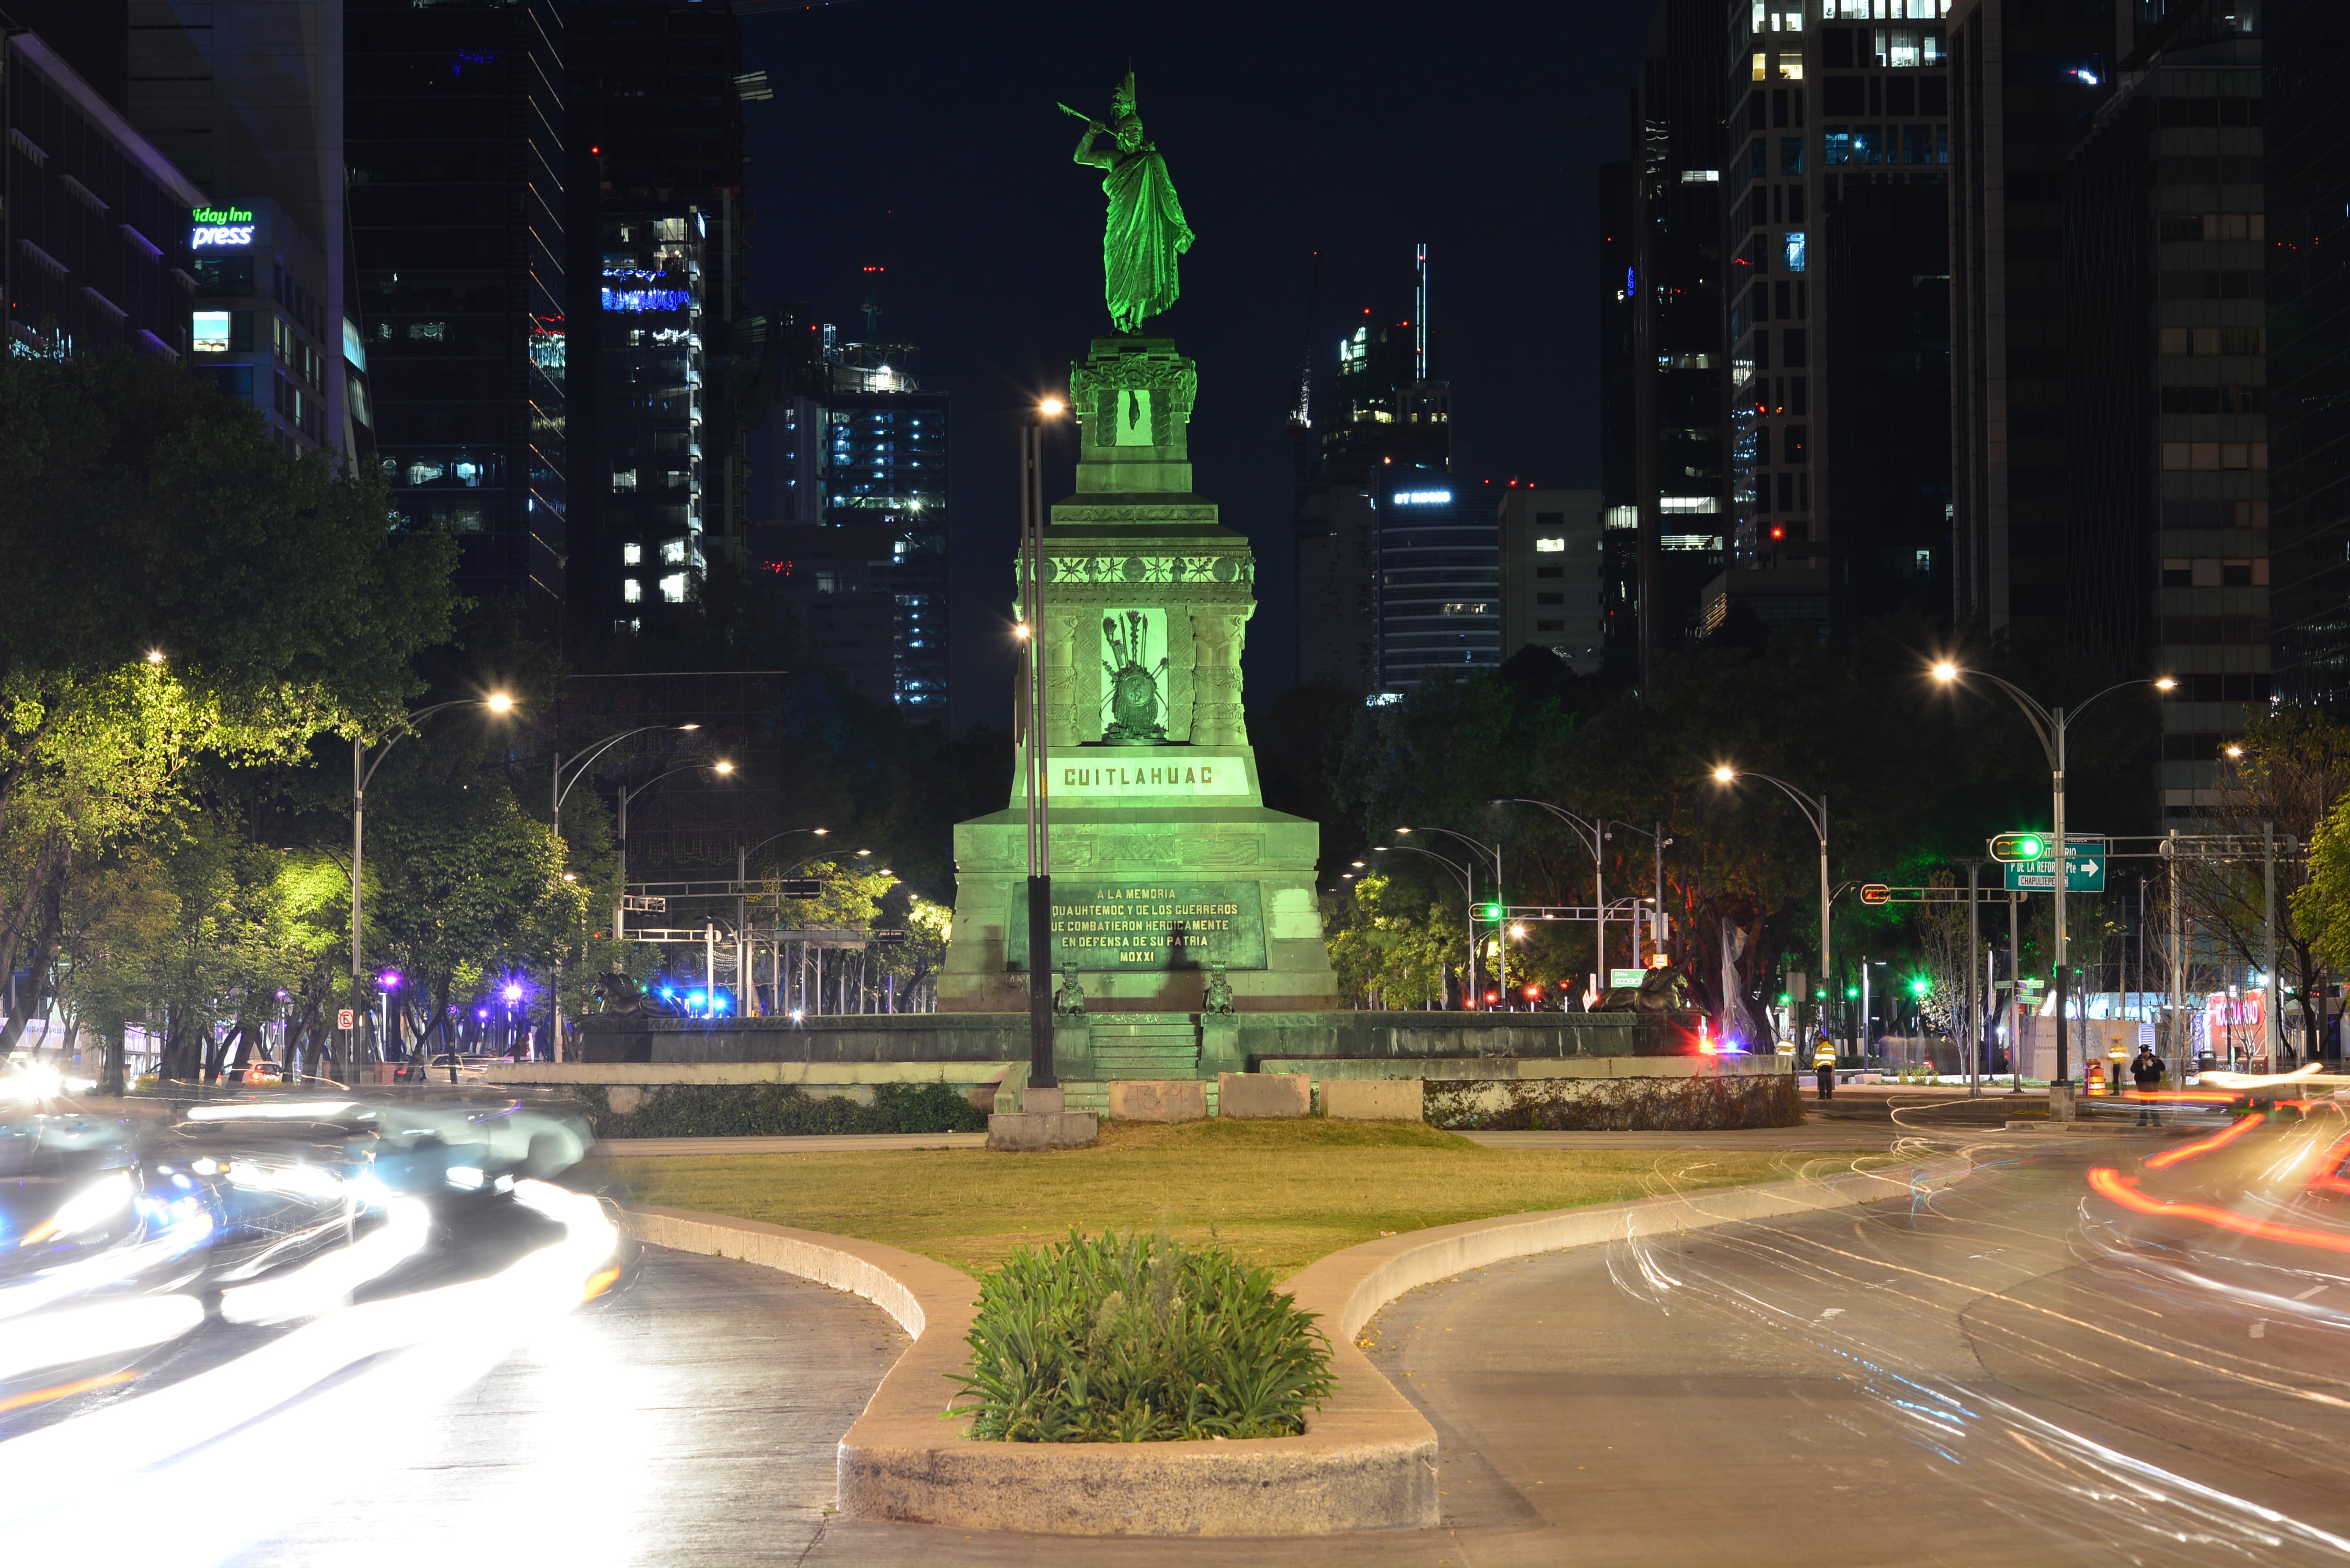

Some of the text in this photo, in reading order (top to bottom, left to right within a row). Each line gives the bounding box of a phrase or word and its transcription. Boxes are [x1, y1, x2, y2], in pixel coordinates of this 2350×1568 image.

[193, 206, 252, 225] iday Inn
[192, 227, 252, 249] press
[1065, 767, 1212, 786] CUITLAHUAC
[2017, 862, 2024, 872] DE
[2027, 862, 2035, 873] LA
[2037, 861, 2060, 873] REFOR
[2066, 862, 2076, 873] Pte
[2021, 877, 2055, 885] CHAPULTEPE
[1098, 889, 1176, 899] A LA MEMORIA
[1127, 905, 1133, 915] Y
[1136, 905, 1149, 915] DE
[1152, 905, 1172, 915] LOS
[1175, 904, 1238, 915] GUERREROS
[1051, 920, 1229, 931] UE COMBATIERON HEROICAMENTE
[1062, 936, 1208, 947] EN DEFENSA DE SU PATRIA
